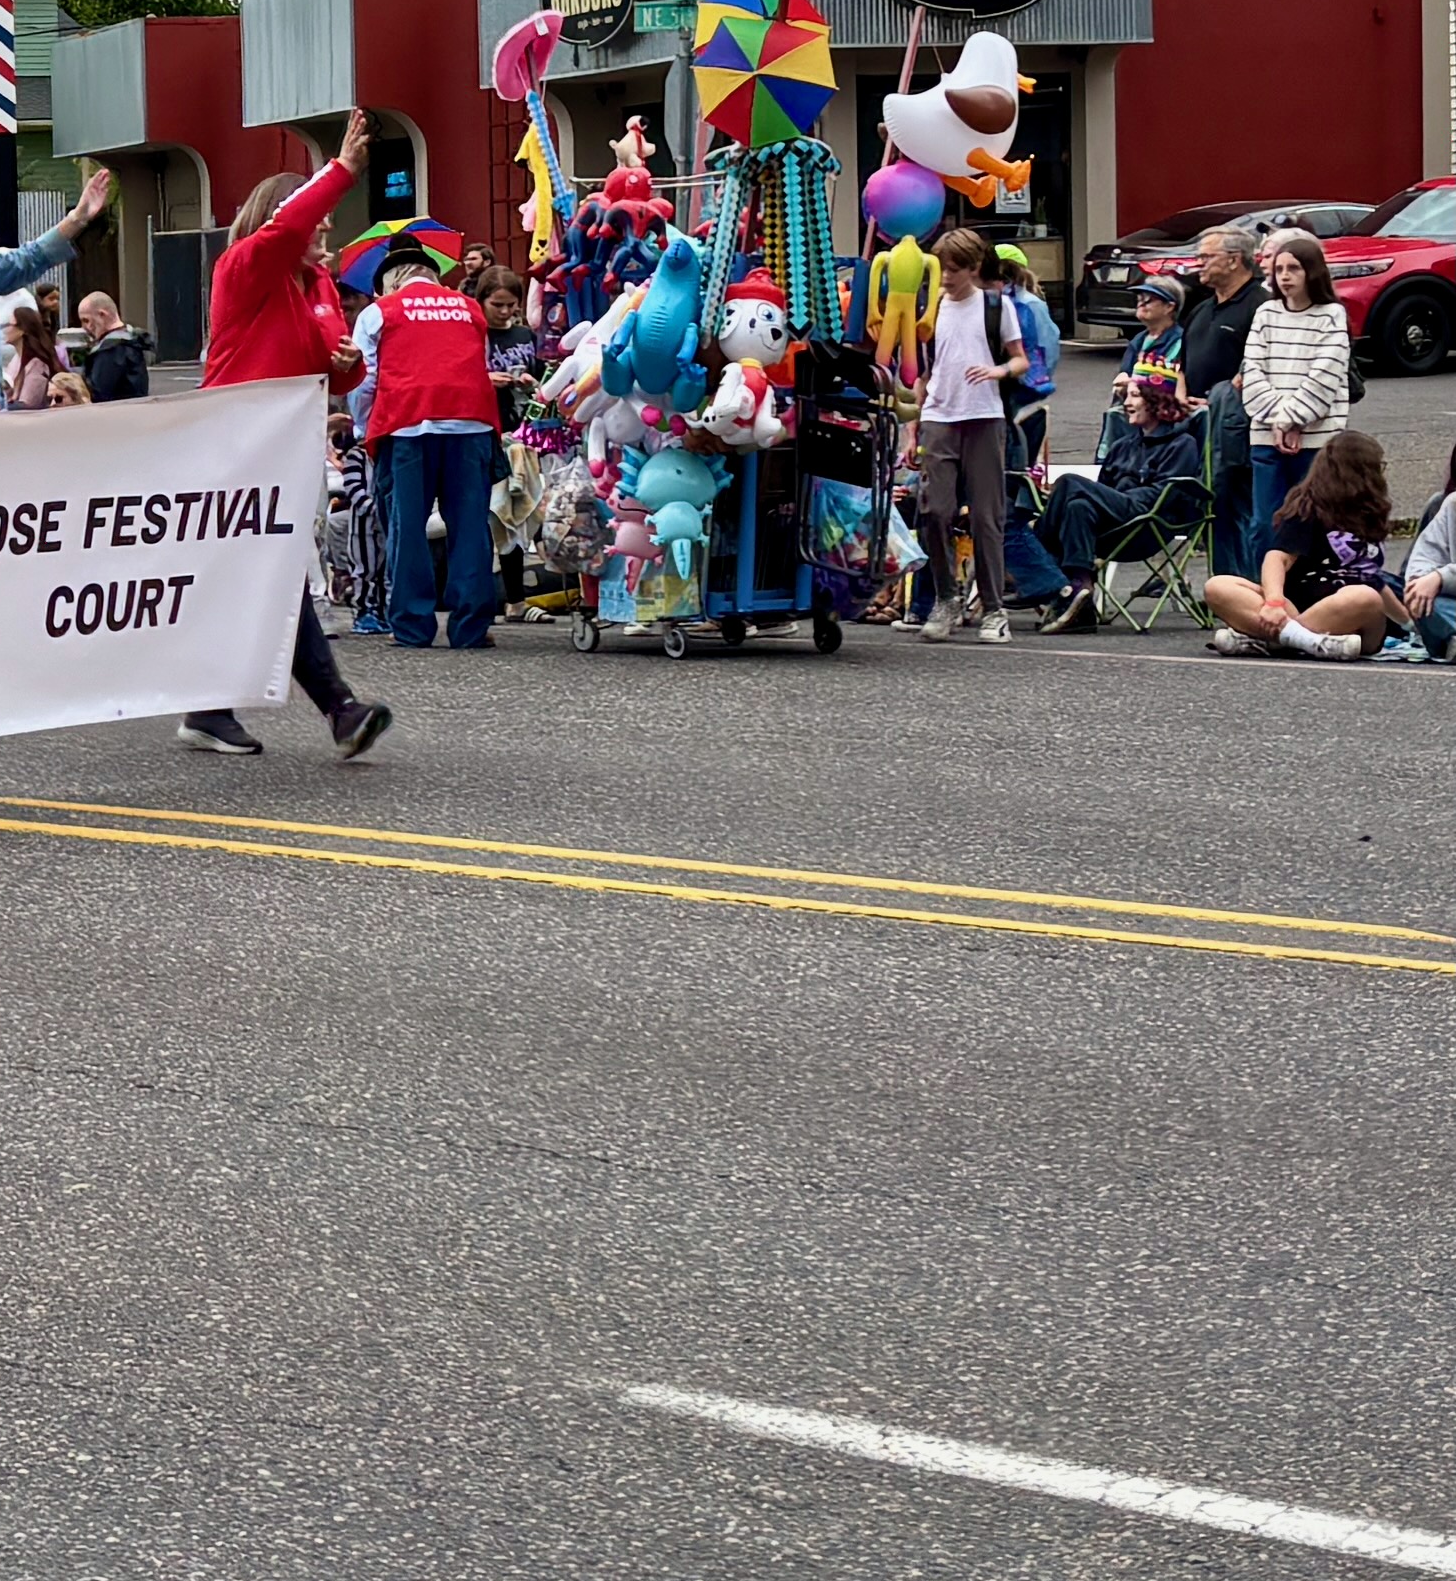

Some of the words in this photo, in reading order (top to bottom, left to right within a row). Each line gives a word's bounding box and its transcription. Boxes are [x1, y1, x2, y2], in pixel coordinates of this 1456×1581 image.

[642, 7, 663, 26] NE
[402, 296, 468, 309] PARADE
[404, 309, 472, 323] VENDOR
[83, 485, 294, 549] FESTIVAL
[45, 575, 194, 638] COURT
